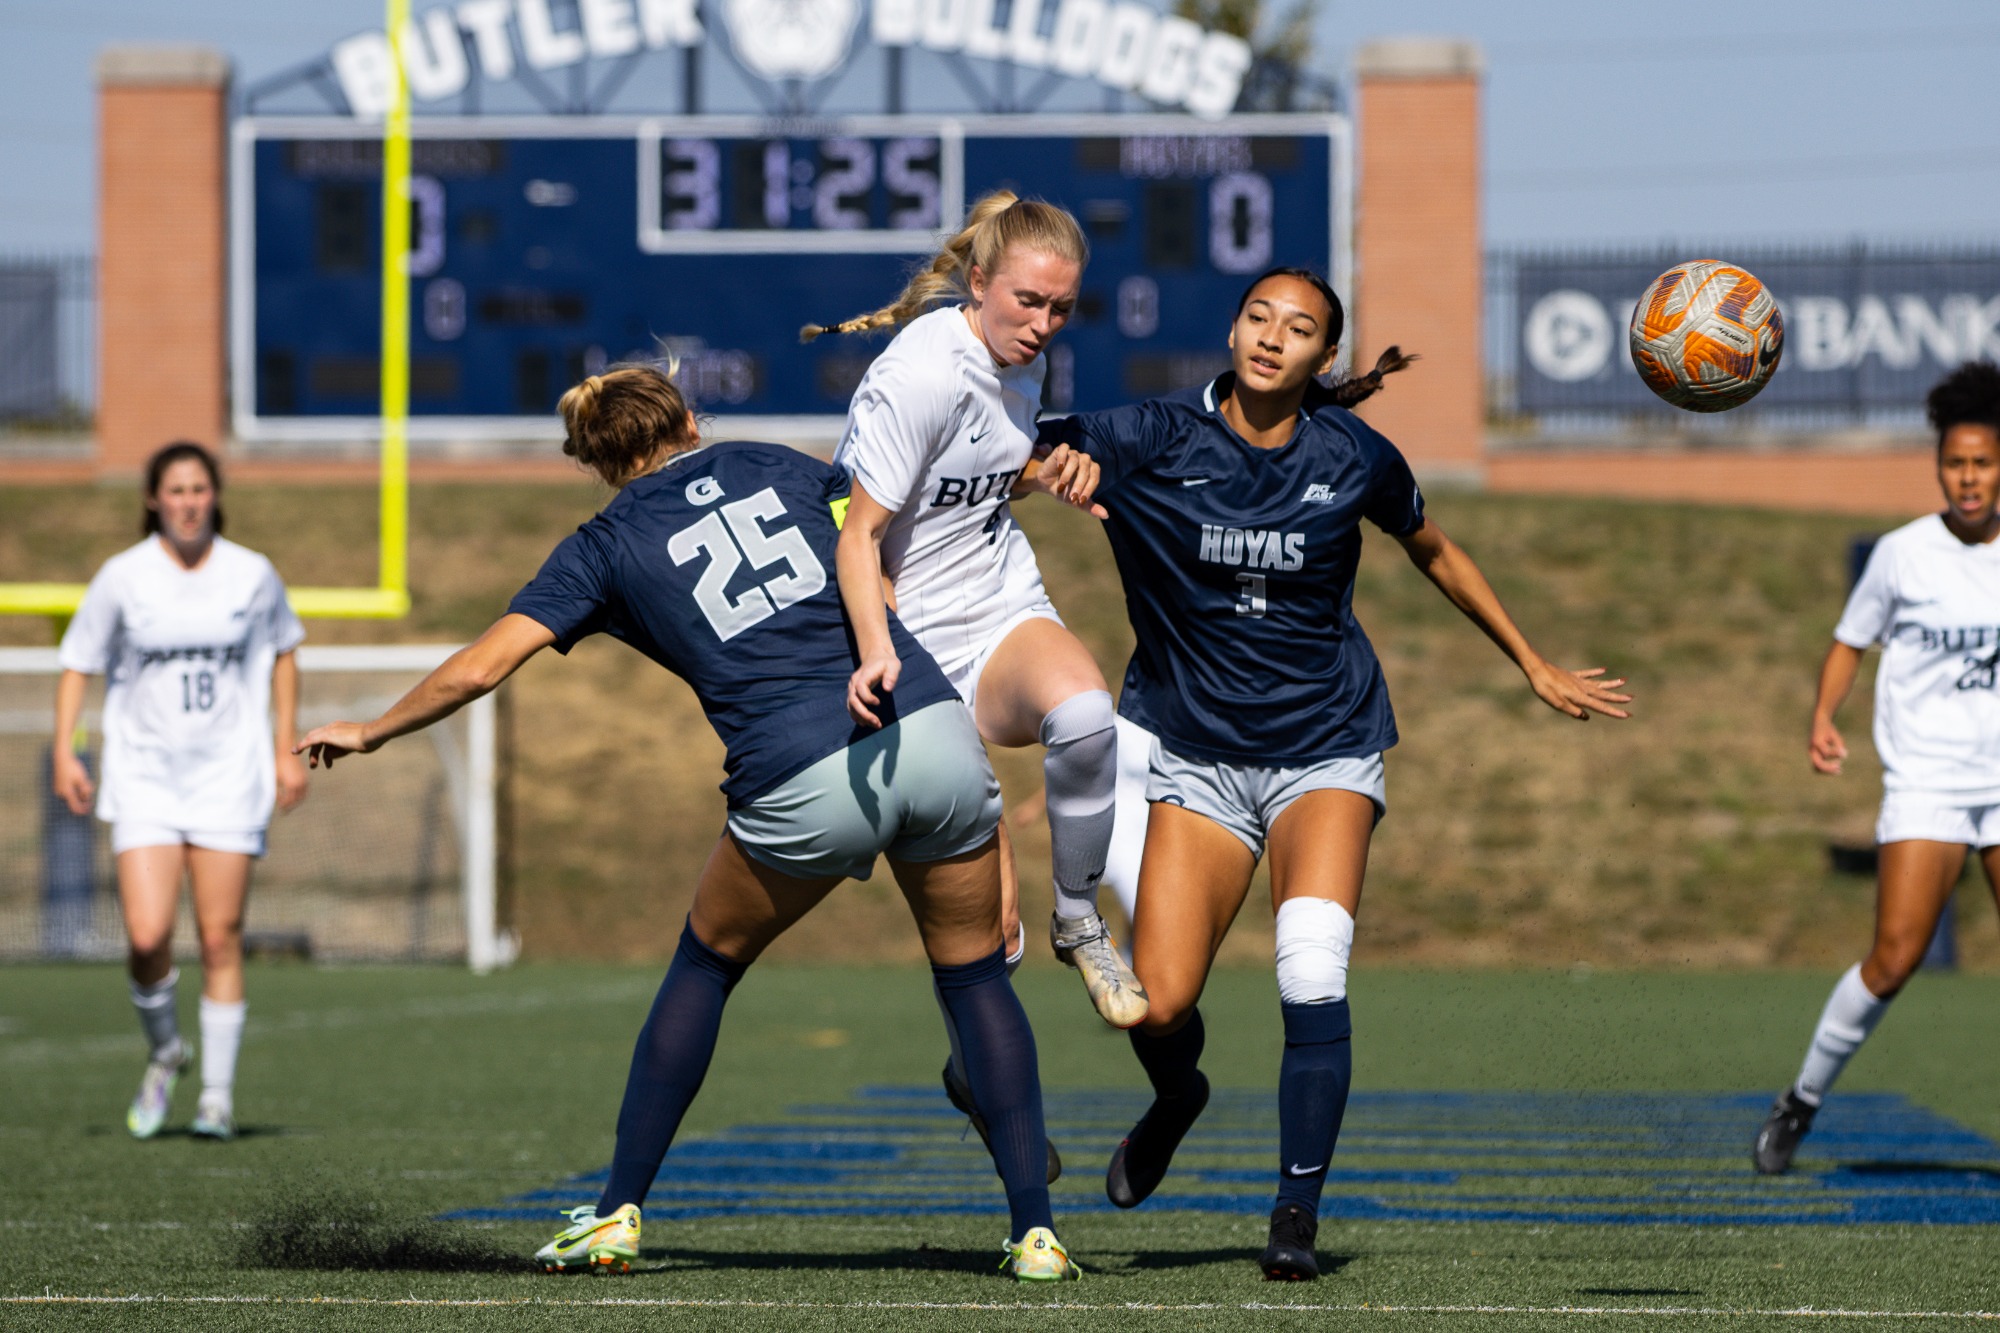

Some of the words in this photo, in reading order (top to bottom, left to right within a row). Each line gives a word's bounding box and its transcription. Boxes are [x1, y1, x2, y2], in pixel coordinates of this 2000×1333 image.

[331, 0, 704, 122] BUTLER
[664, 137, 942, 230] 31:25
[1209, 171, 1274, 274] 0
[1719, 328, 1749, 345] FLIGHT
[1798, 293, 2000, 371] BANK
[685, 476, 726, 506] G
[930, 468, 1022, 507] BUT
[1303, 490, 1337, 501] EAST
[1308, 483, 1331, 493] BIG
[667, 486, 828, 643] 25
[1199, 524, 1305, 571] HOYAS
[1236, 572, 1267, 618] 3
[1921, 626, 2000, 652] BUT
[183, 672, 215, 713] 18
